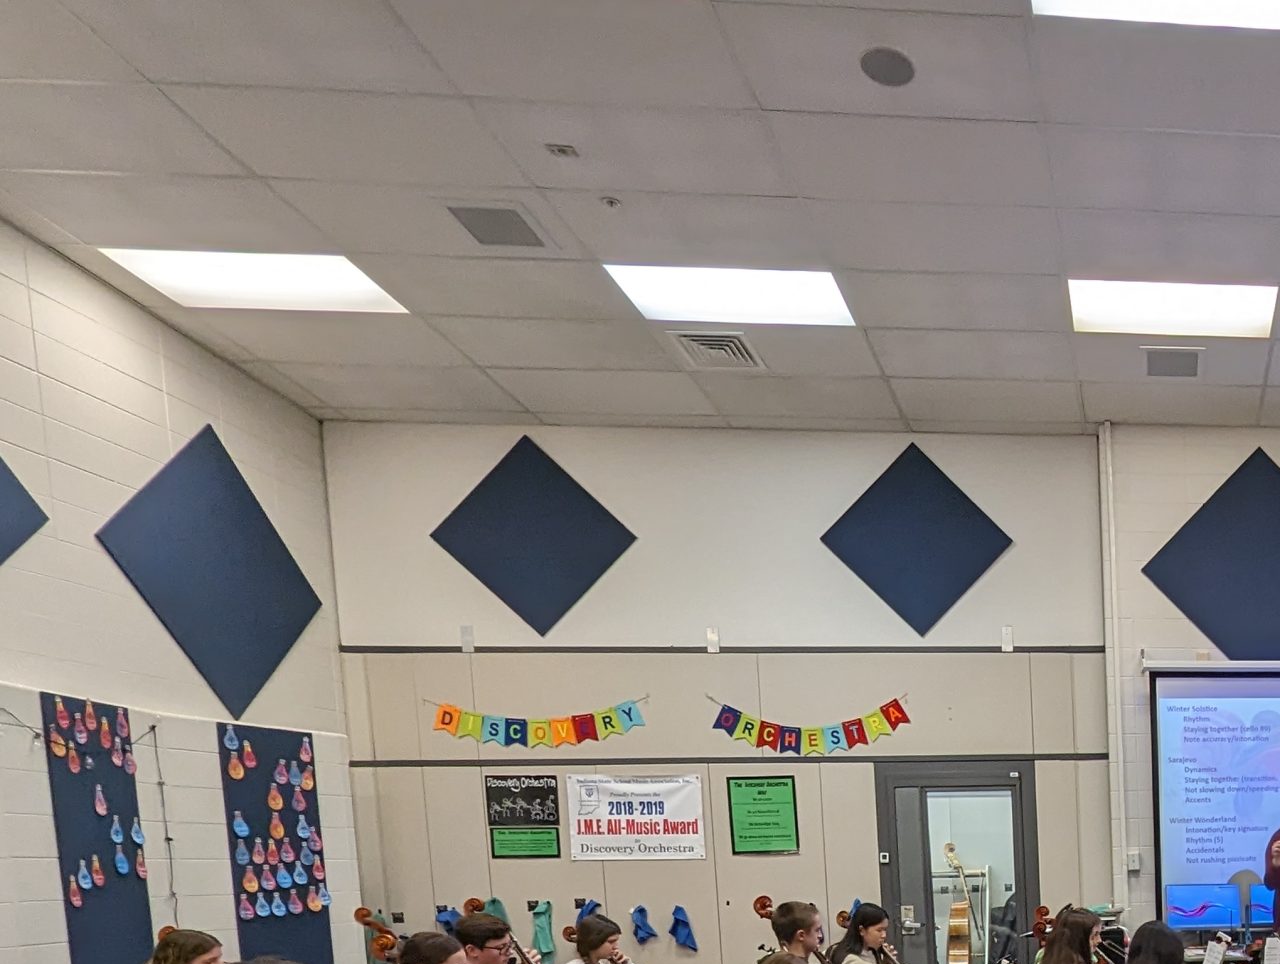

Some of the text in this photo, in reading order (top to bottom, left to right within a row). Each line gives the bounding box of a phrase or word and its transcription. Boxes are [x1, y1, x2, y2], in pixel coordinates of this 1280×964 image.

[1166, 705, 1218, 713] Winter Solstice
[440, 706, 633, 741] DISCOVERY
[1183, 715, 1210, 724] Rhythm
[720, 706, 902, 748] ORCHESTRA
[1183, 726, 1208, 734] Staying
[1210, 726, 1239, 734] together
[1168, 756, 1197, 764] Sarajevo
[1184, 766, 1217, 774] Dynamics
[1184, 776, 1209, 784] Staying
[1210, 776, 1240, 784] together
[1184, 786, 1198, 794] Not
[1199, 786, 1225, 794] slowing
[1184, 796, 1211, 804] Accents
[608, 801, 665, 815] 2018-2019
[576, 819, 699, 835] J.M.E. All-Music Award
[1185, 825, 1269, 834] Intonation/key signature
[1185, 836, 1224, 845] Rhythm (5)
[580, 843, 695, 855] Discovery Orchestra
[1200, 856, 1226, 864] rushing
